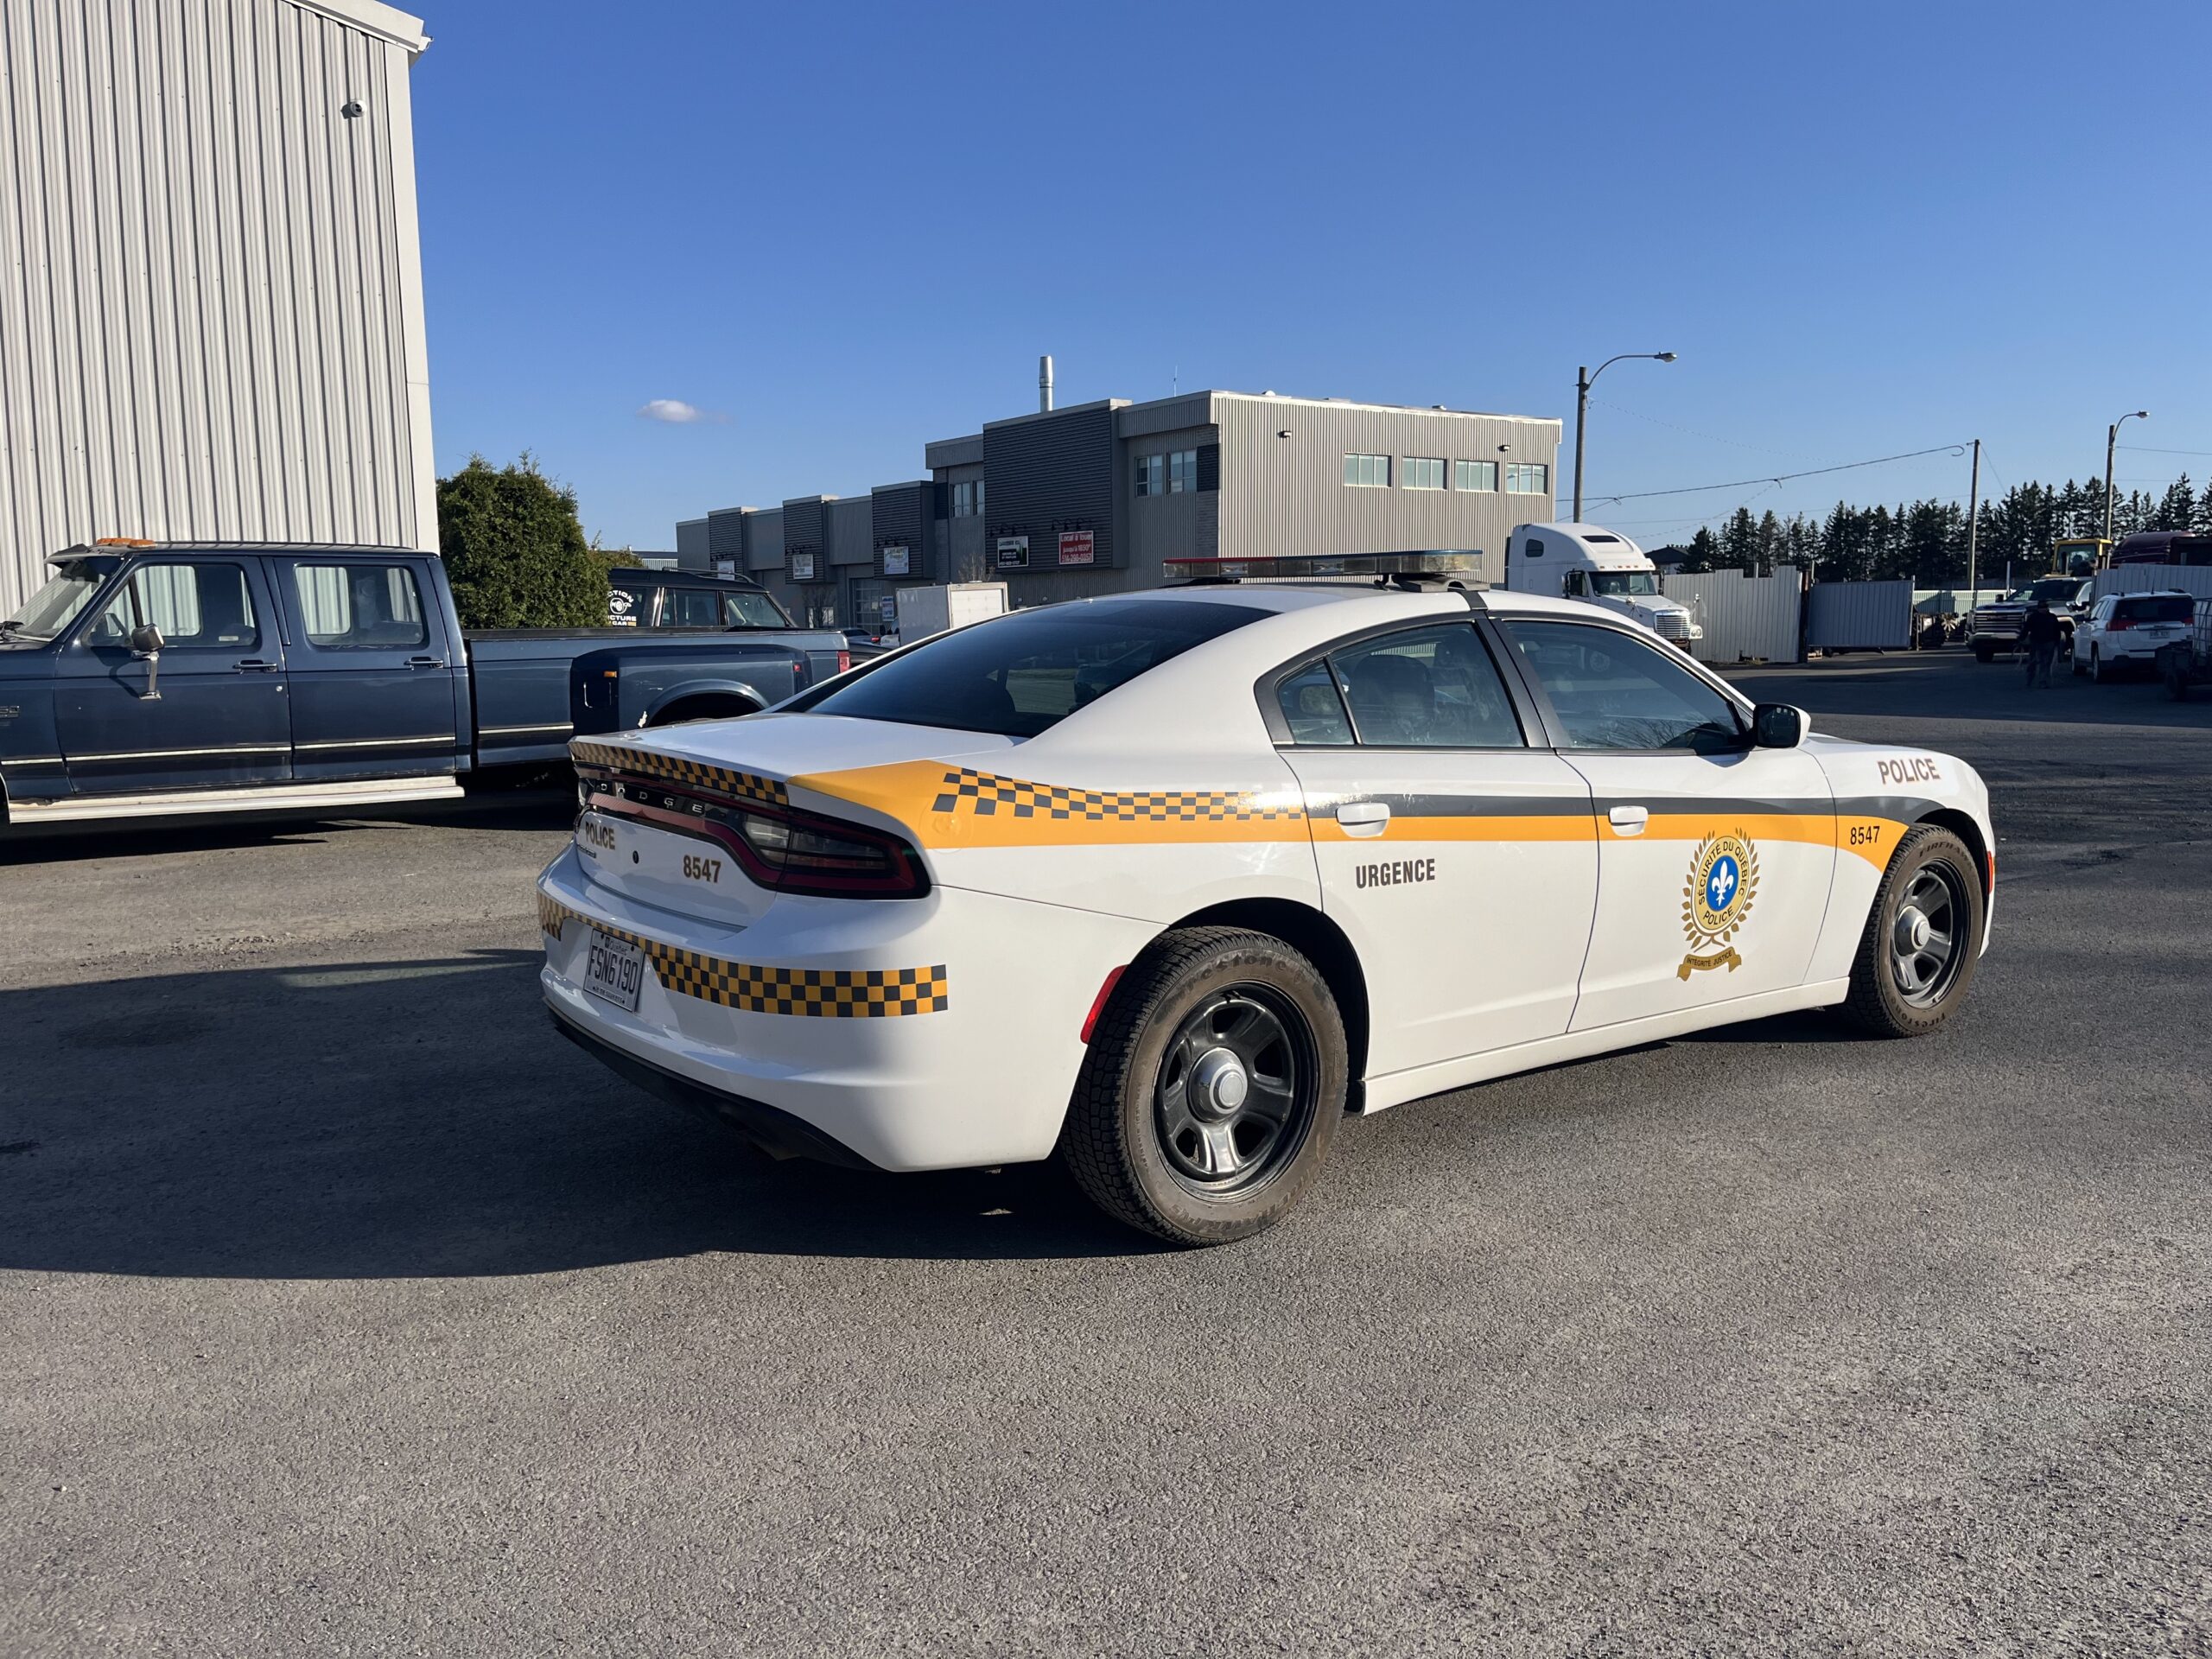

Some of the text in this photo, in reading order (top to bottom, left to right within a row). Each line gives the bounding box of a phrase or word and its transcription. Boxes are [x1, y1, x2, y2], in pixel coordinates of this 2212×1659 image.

[1878, 759, 1941, 785] POLICE
[600, 783, 702, 814] DODGE
[585, 822, 616, 850] POLICE
[1850, 826, 1880, 845] 8547
[683, 855, 721, 883] 8547
[1356, 858, 1436, 889] URGENCE
[1699, 841, 1748, 905] SÉCURITÉ DU QUÉBEC
[1703, 906, 1734, 925] POLICE
[588, 945, 639, 995] FSN6190
[1713, 950, 1732, 966] JUSTICE
